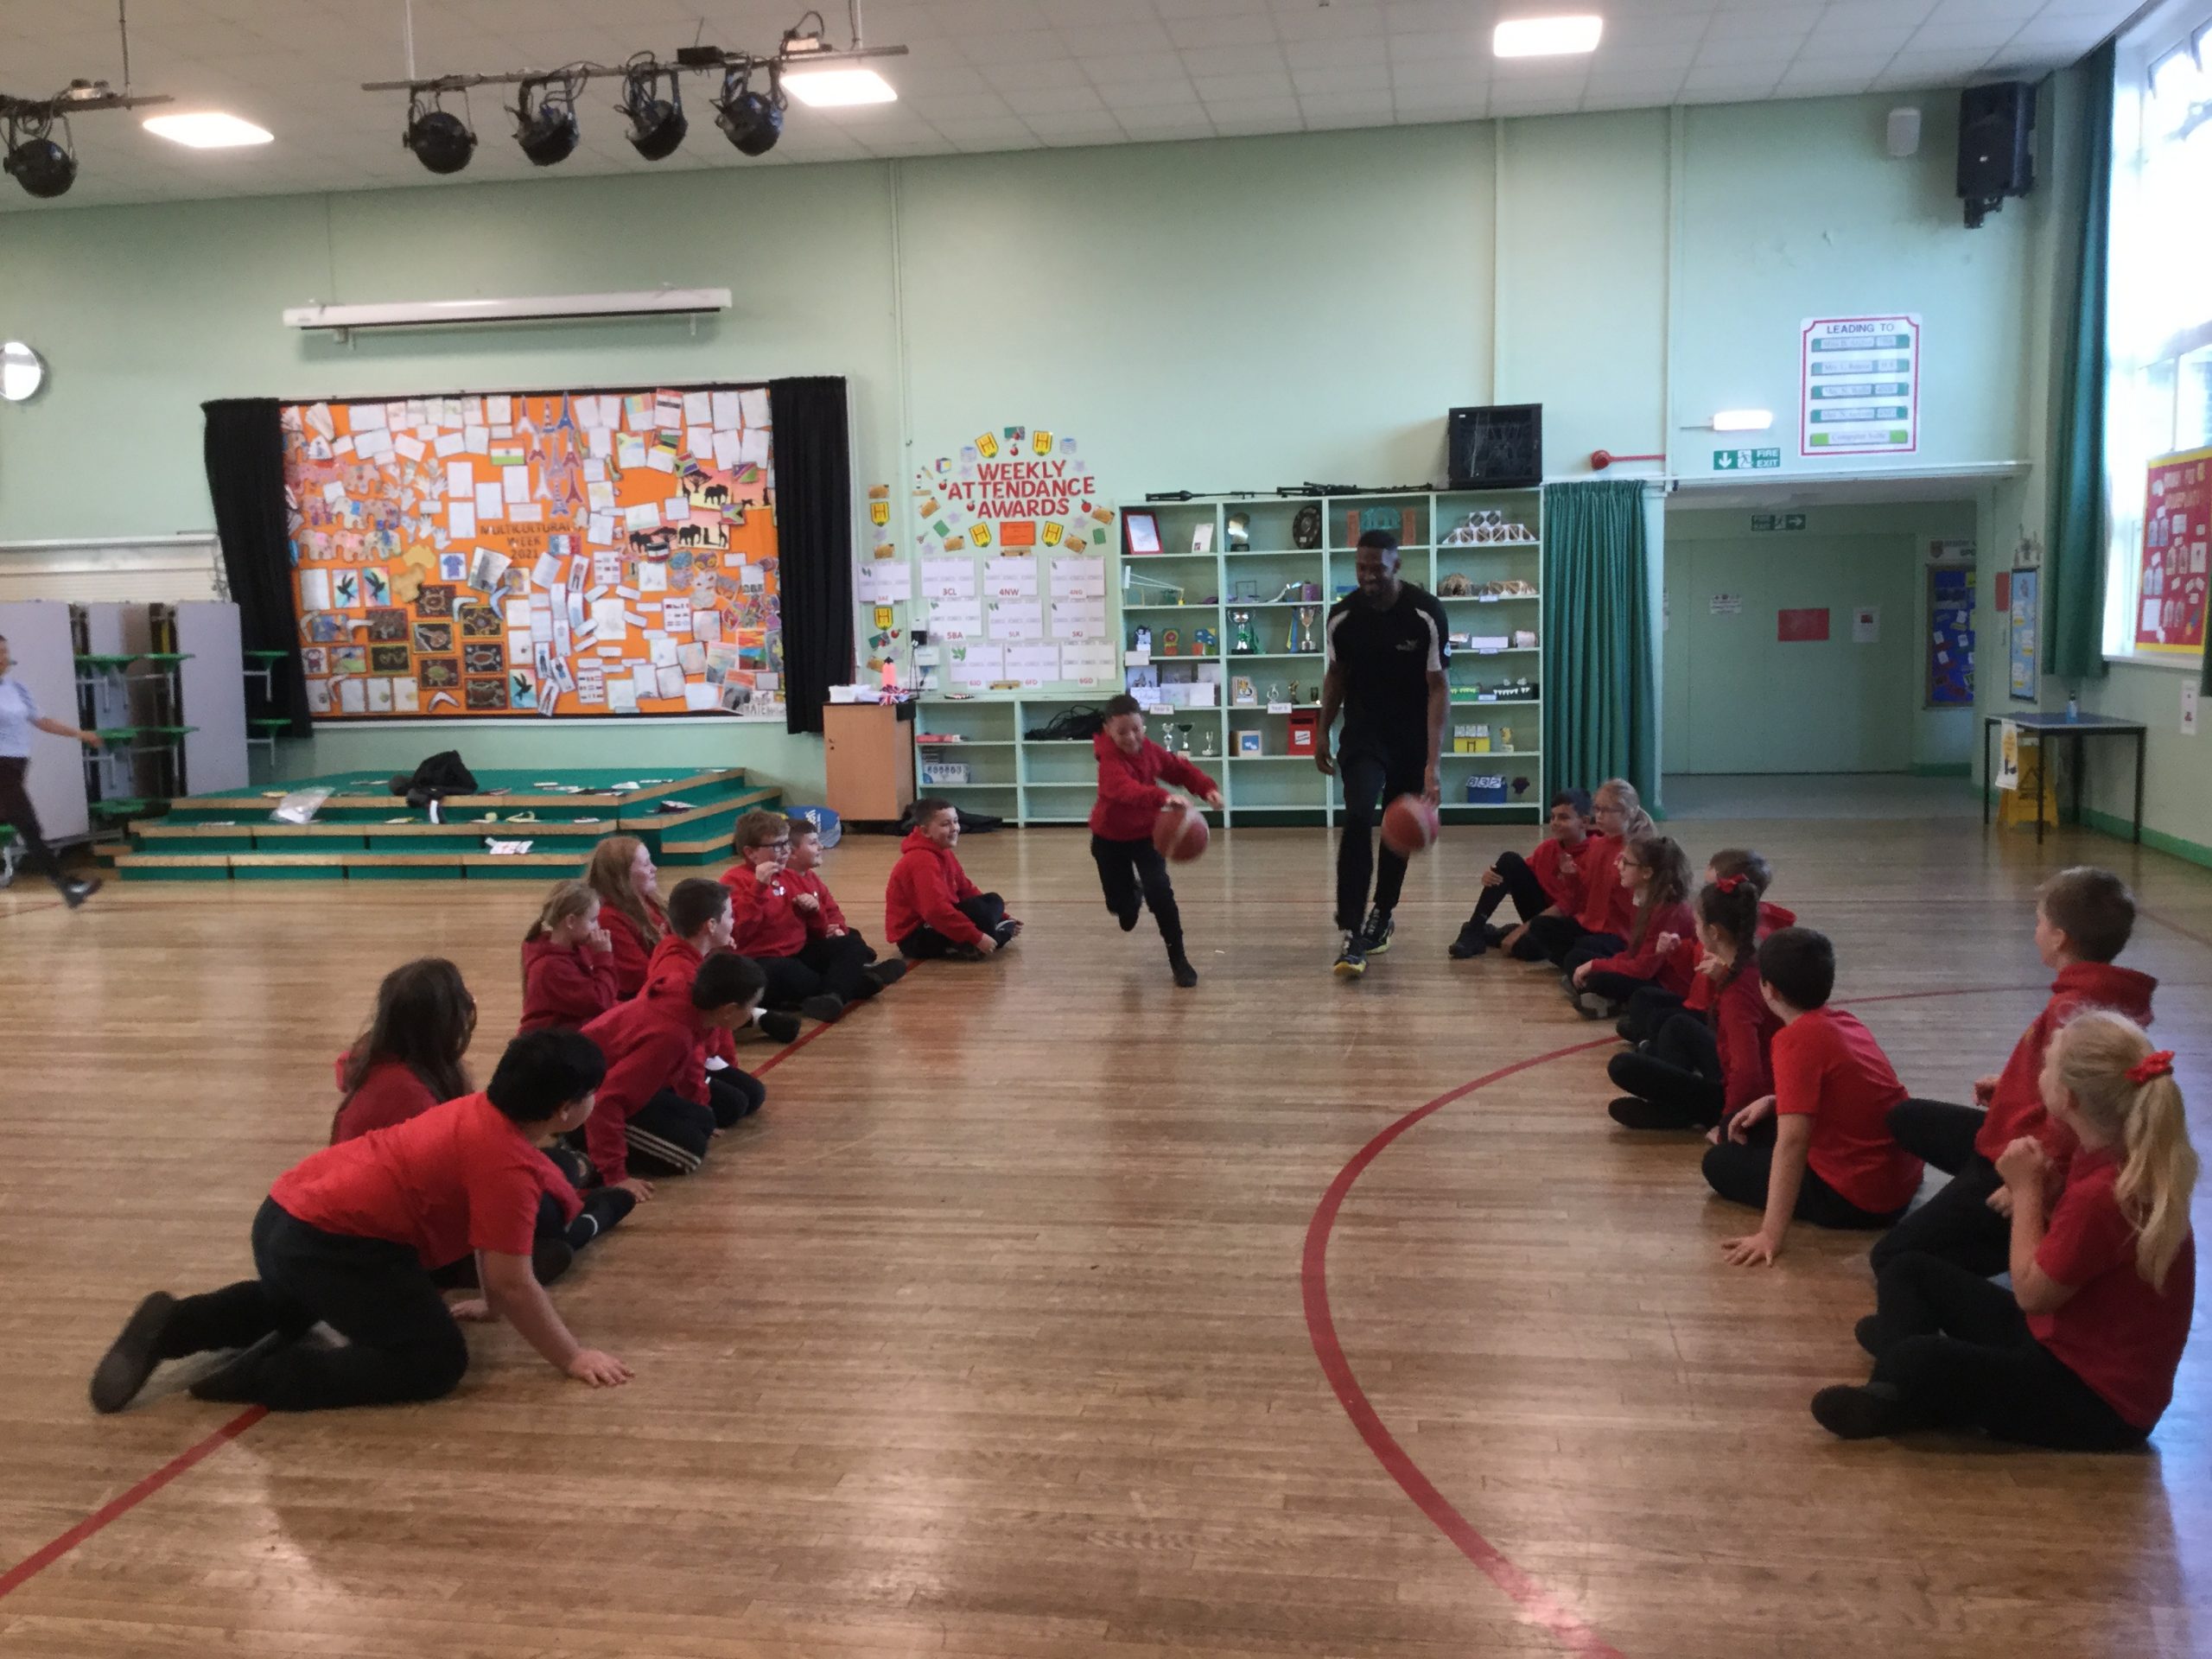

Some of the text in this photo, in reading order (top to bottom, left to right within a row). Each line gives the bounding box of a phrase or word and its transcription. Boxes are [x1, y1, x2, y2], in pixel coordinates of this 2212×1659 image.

[1827, 323, 1894, 334] LEADING TO
[1757, 448, 1778, 457] FIRE
[977, 460, 1066, 480] WEEKLY
[948, 476, 1096, 499] ATTENDANCE
[977, 498, 1070, 518] AWARDS
[507, 537, 541, 546] WEEK
[511, 549, 539, 559] 2021
